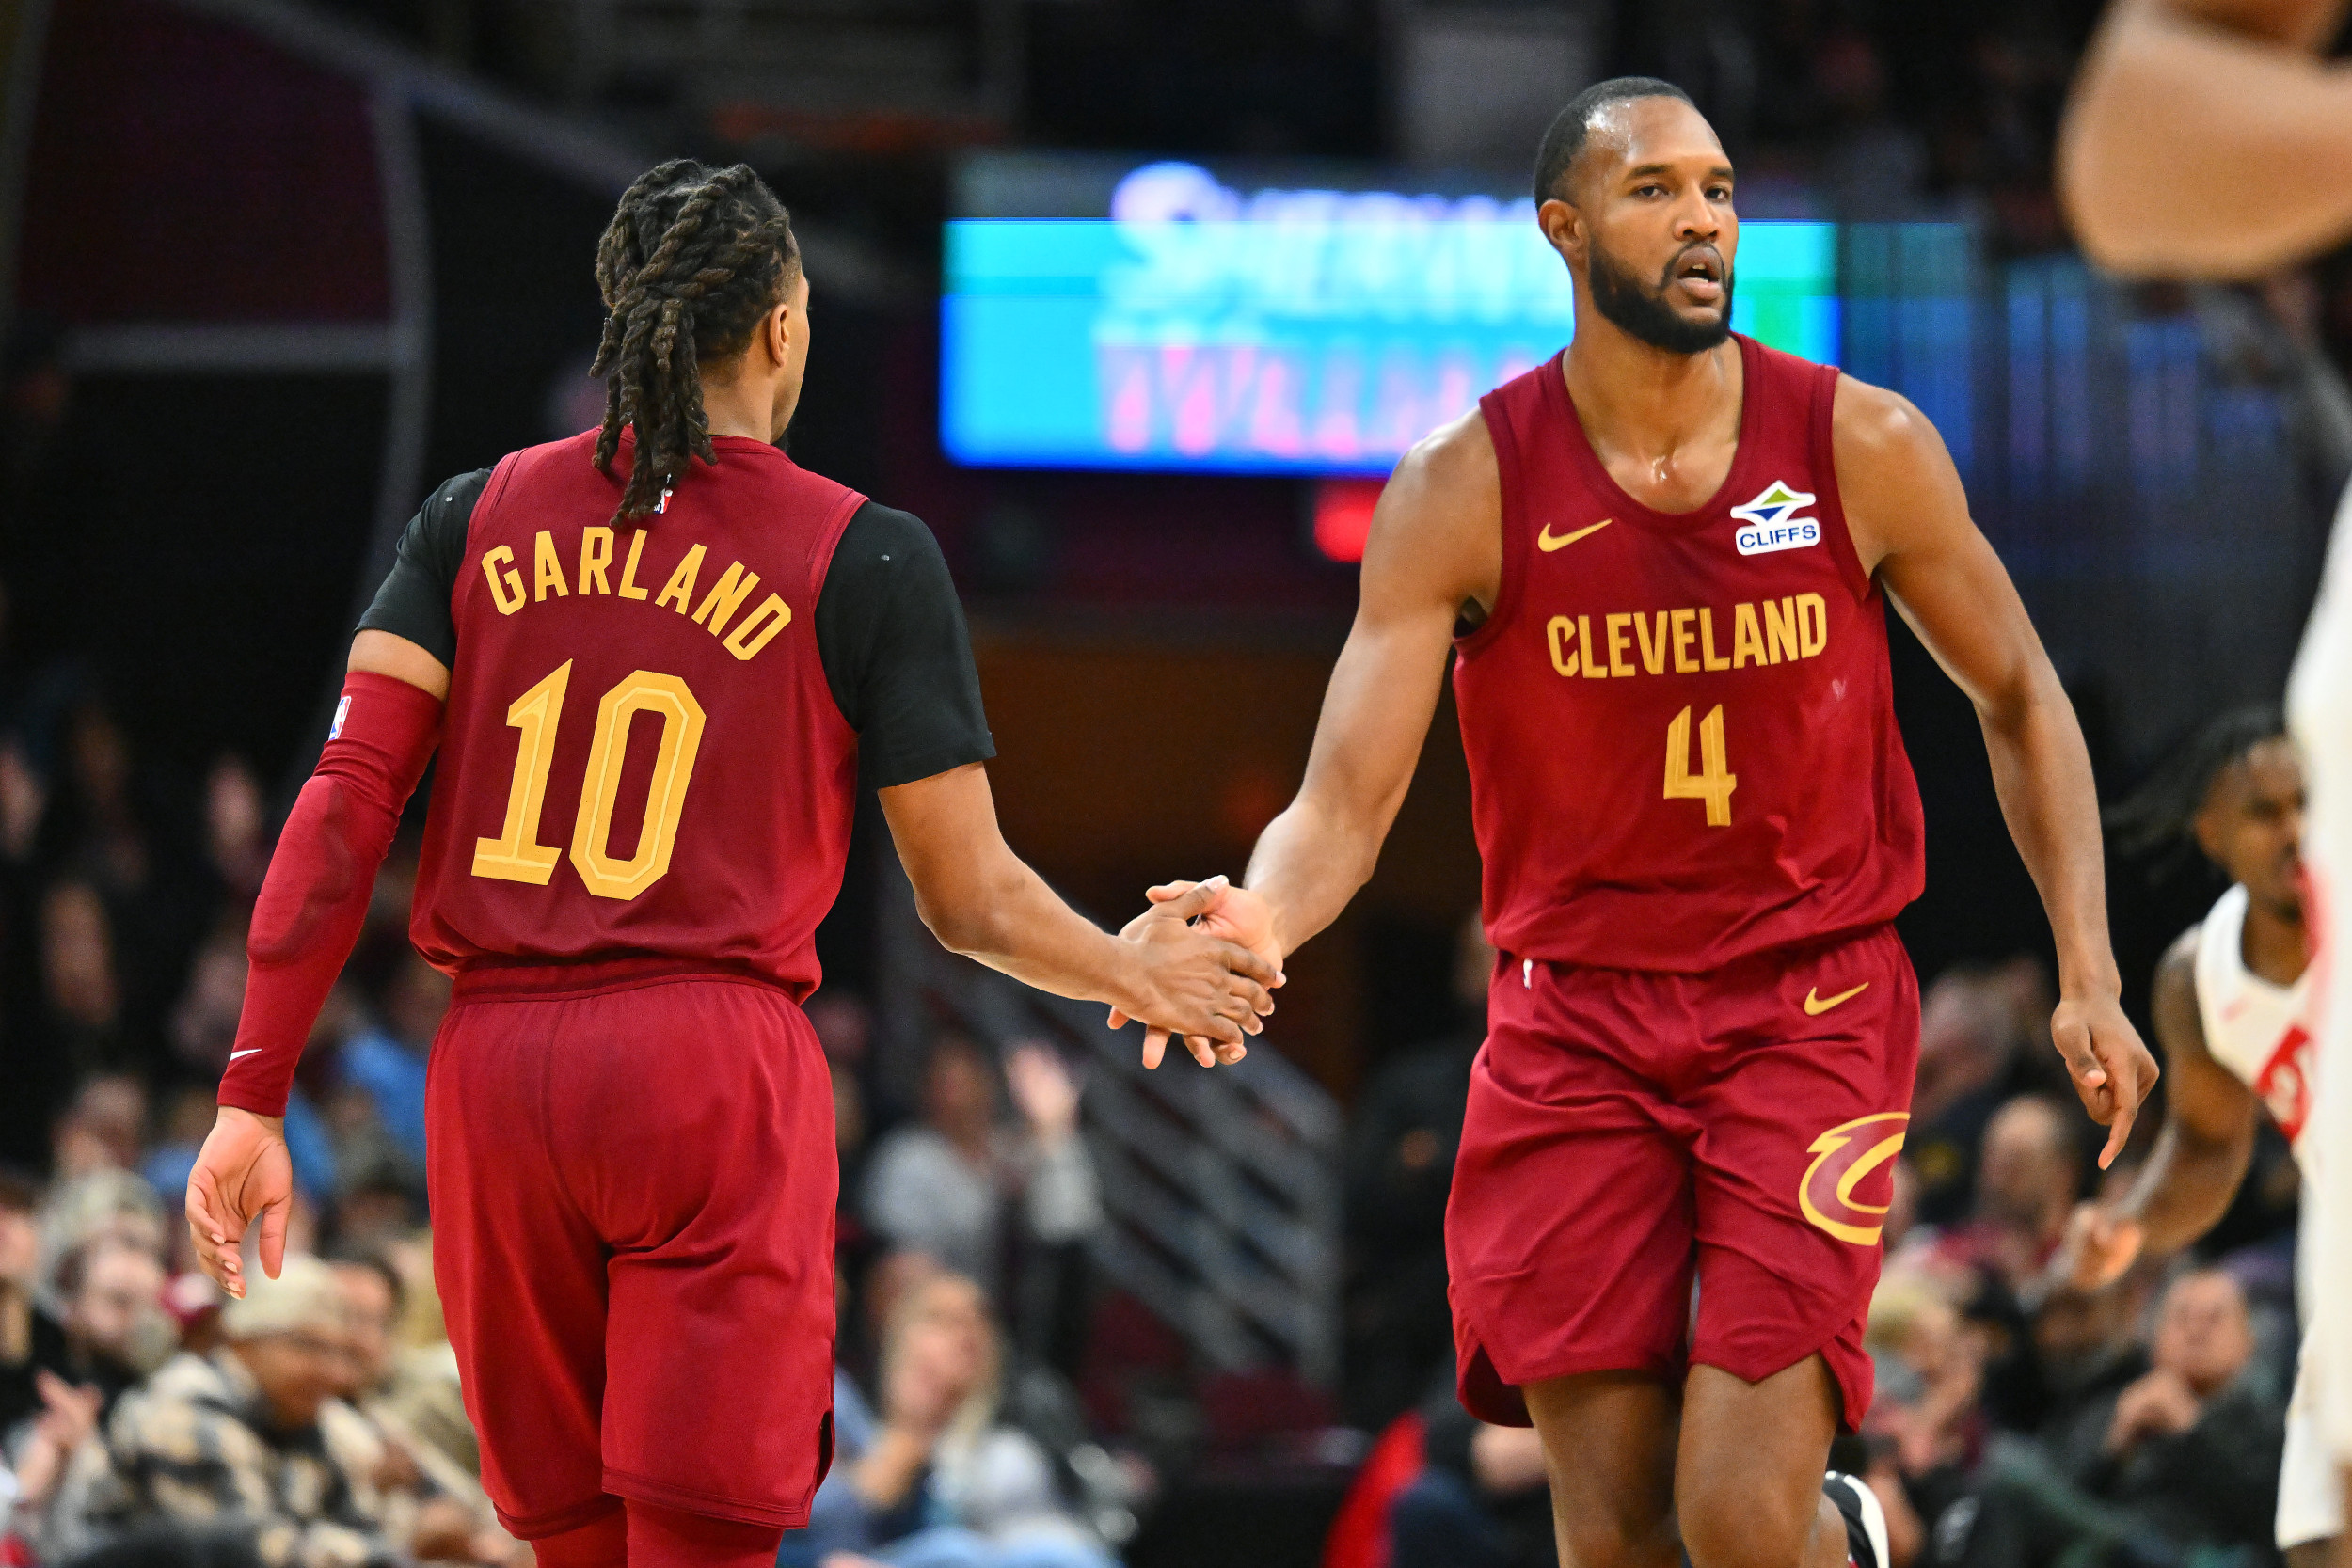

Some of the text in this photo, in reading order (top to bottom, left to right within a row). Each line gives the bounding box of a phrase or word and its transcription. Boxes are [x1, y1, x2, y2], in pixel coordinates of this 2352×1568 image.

[481, 526, 792, 661] GARLAND
[1740, 525, 1817, 548] CLIFFS
[1546, 592, 1828, 679] CLEVELAND
[470, 657, 707, 901] 10
[1663, 704, 1737, 828] 4
